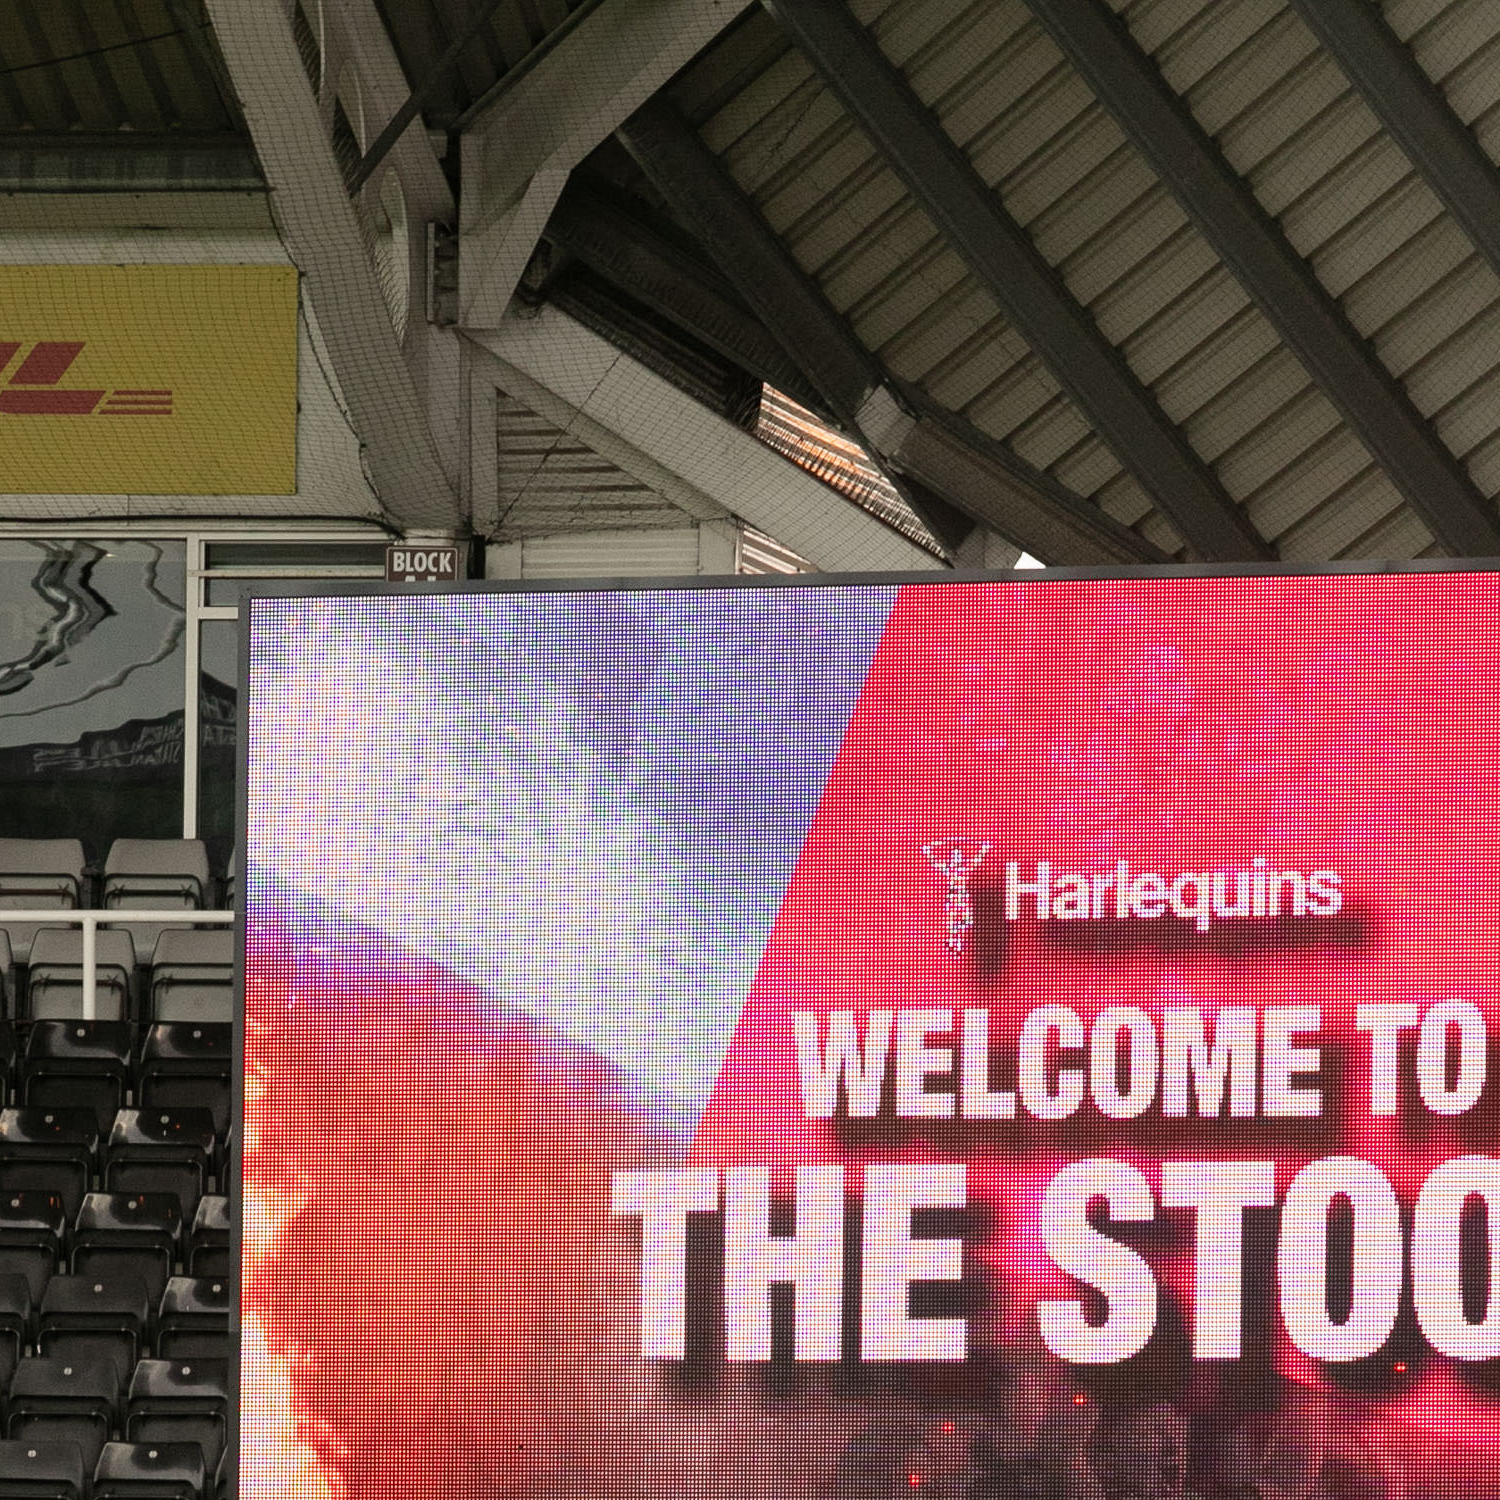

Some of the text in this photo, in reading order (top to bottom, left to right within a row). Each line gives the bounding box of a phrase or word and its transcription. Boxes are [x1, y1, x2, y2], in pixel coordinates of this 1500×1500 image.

[393, 551, 452, 573] BLOCK
[1005, 857, 1343, 931] Harlequins
[790, 997, 1488, 1121] WELCOME TO
[611, 1162, 970, 1364] THE
